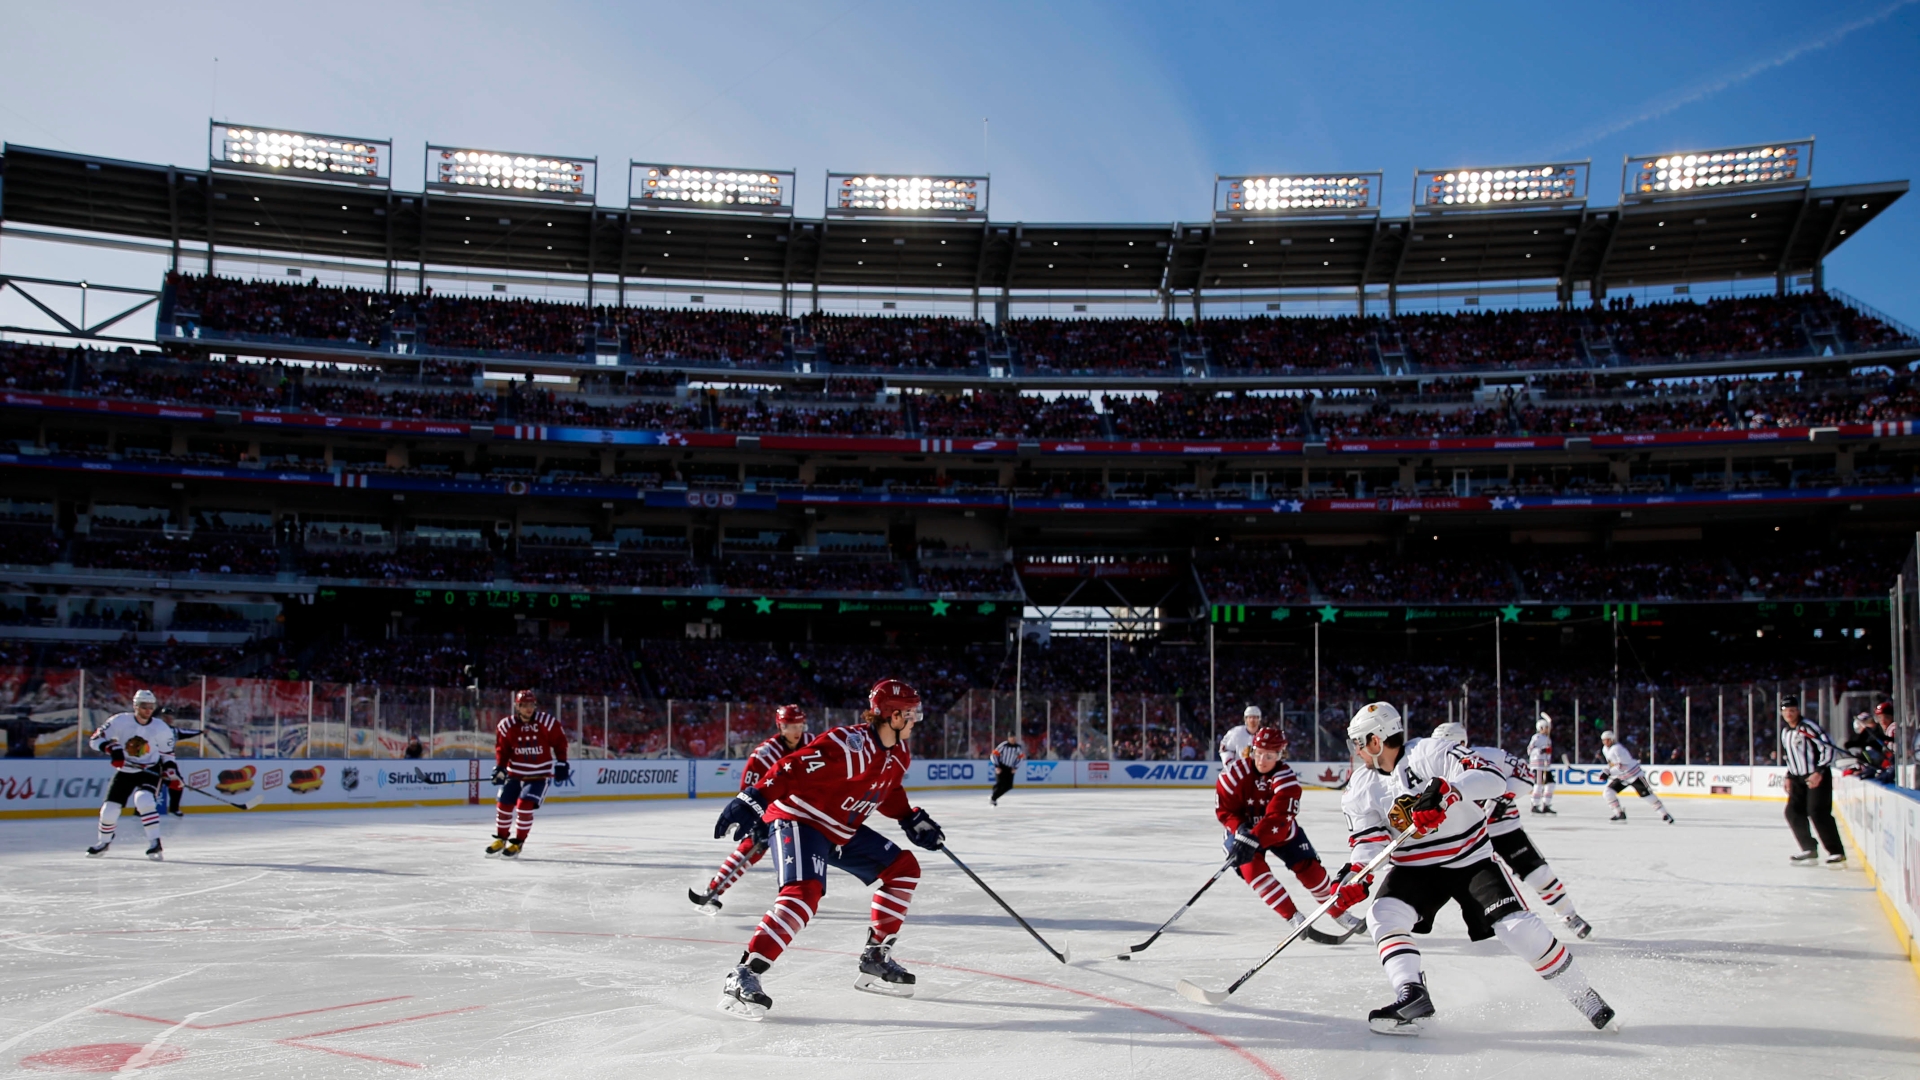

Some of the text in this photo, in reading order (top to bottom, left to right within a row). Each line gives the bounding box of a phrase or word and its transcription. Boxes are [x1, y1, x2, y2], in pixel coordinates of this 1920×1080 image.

[425, 426, 461, 434] HONDA
[1424, 501, 1460, 509] CLASSIC
[444, 591, 455, 605] 0
[549, 594, 560, 608] 0
[892, 686, 901, 695] W
[514, 746, 543, 755] CAPITALS
[801, 750, 826, 774] 74
[596, 768, 679, 785] BRIDGESTONE
[744, 771, 760, 786] 83
[927, 763, 974, 780] GEICO
[1146, 764, 1208, 780] ANCO
[1404, 766, 1423, 789] A
[1552, 769, 1609, 785] ICO
[1648, 770, 1705, 787] COVER
[35, 777, 111, 799] LIGH
[1287, 797, 1300, 815] 19
[811, 857, 825, 877] W
